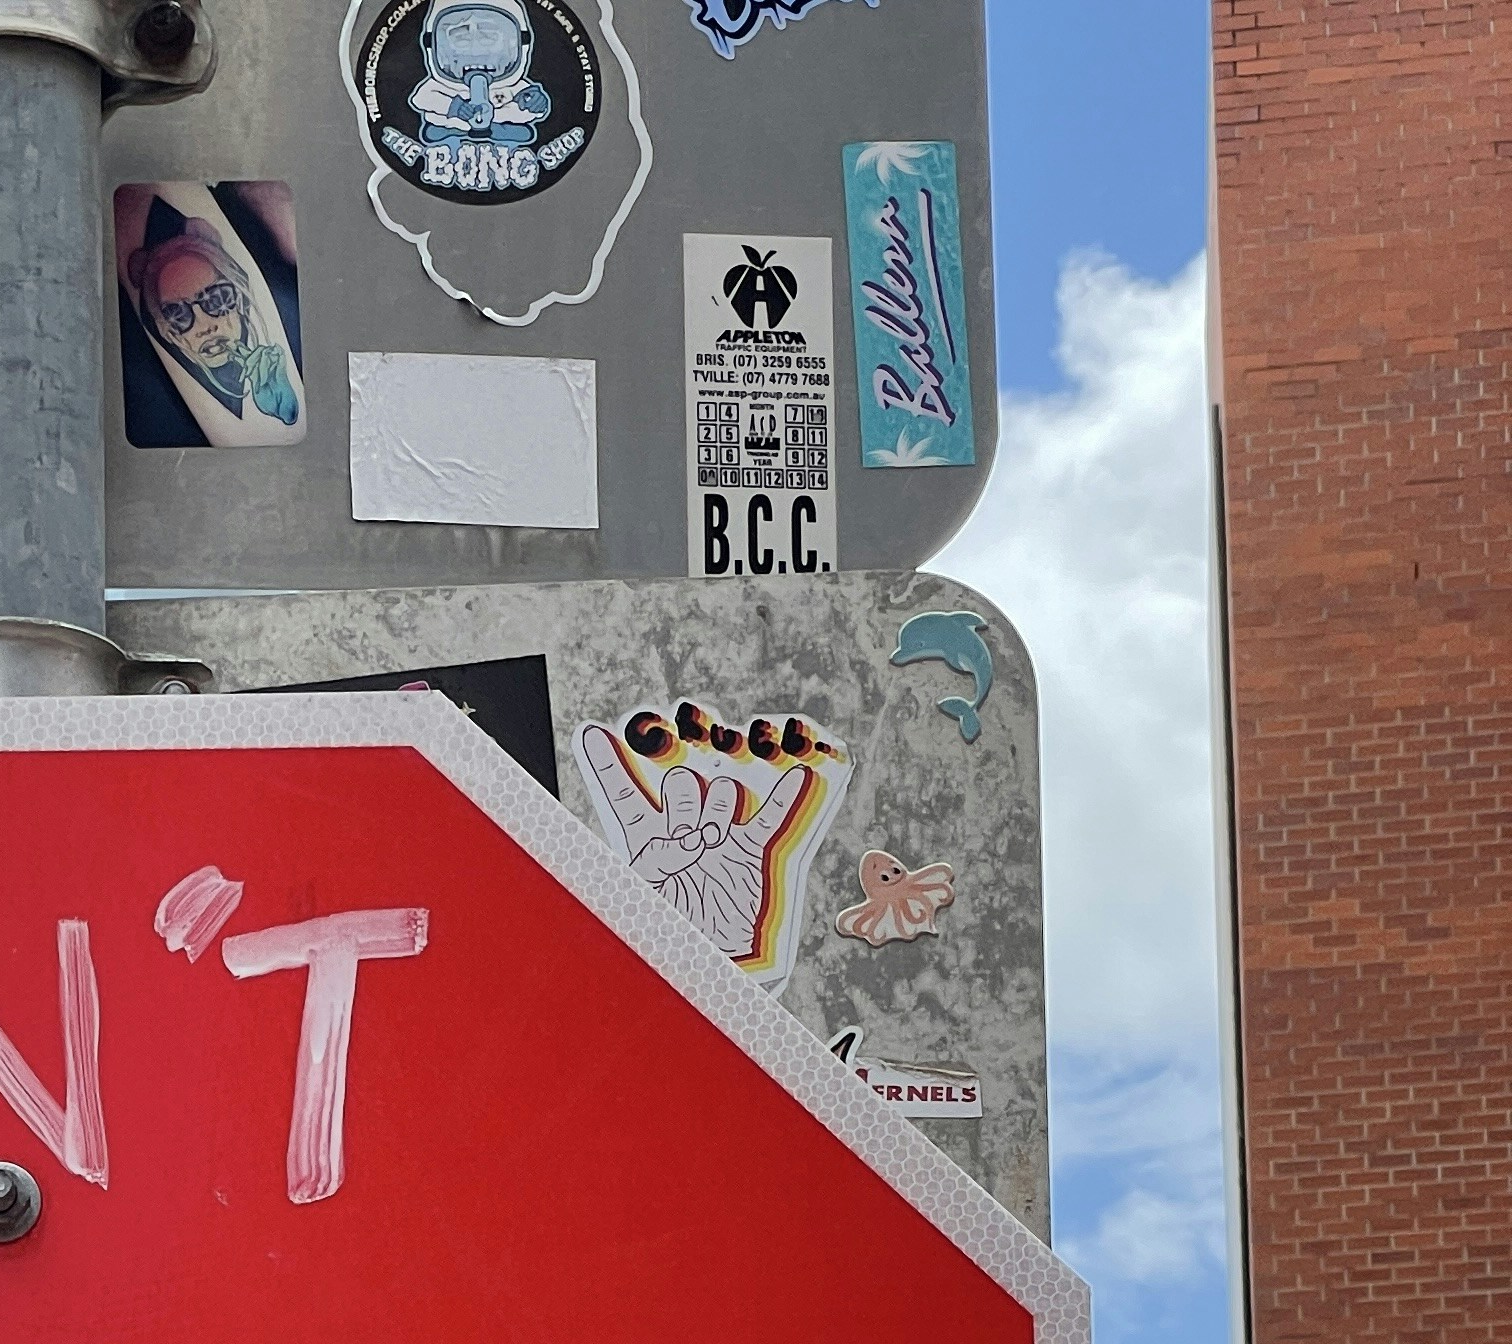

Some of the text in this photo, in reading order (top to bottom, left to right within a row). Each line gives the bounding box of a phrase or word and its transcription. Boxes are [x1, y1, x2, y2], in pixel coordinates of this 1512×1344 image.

[382, 128, 584, 189] THE BONG SHOP
[716, 330, 807, 345] APPLETON
[715, 343, 807, 354] TRAFFIC EQUIPMENT
[696, 353, 826, 370] BRIS. (07) 3259 6555
[742, 371, 765, 387] (07)
[769, 372, 798, 386] 4779
[801, 373, 830, 387] 7688
[704, 405, 710, 419] 1
[724, 405, 733, 419] 4
[791, 407, 799, 421] 7
[703, 426, 824, 444] 2 5 8 11
[703, 448, 712, 462] 3
[725, 448, 734, 463] 6
[791, 450, 800, 465] 9
[809, 451, 826, 466] 12
[722, 470, 738, 484] 10
[745, 470, 759, 485] 11
[766, 471, 781, 486] 12
[788, 472, 804, 486] 13
[810, 472, 826, 487] 14
[703, 492, 830, 575] B.C.C.
